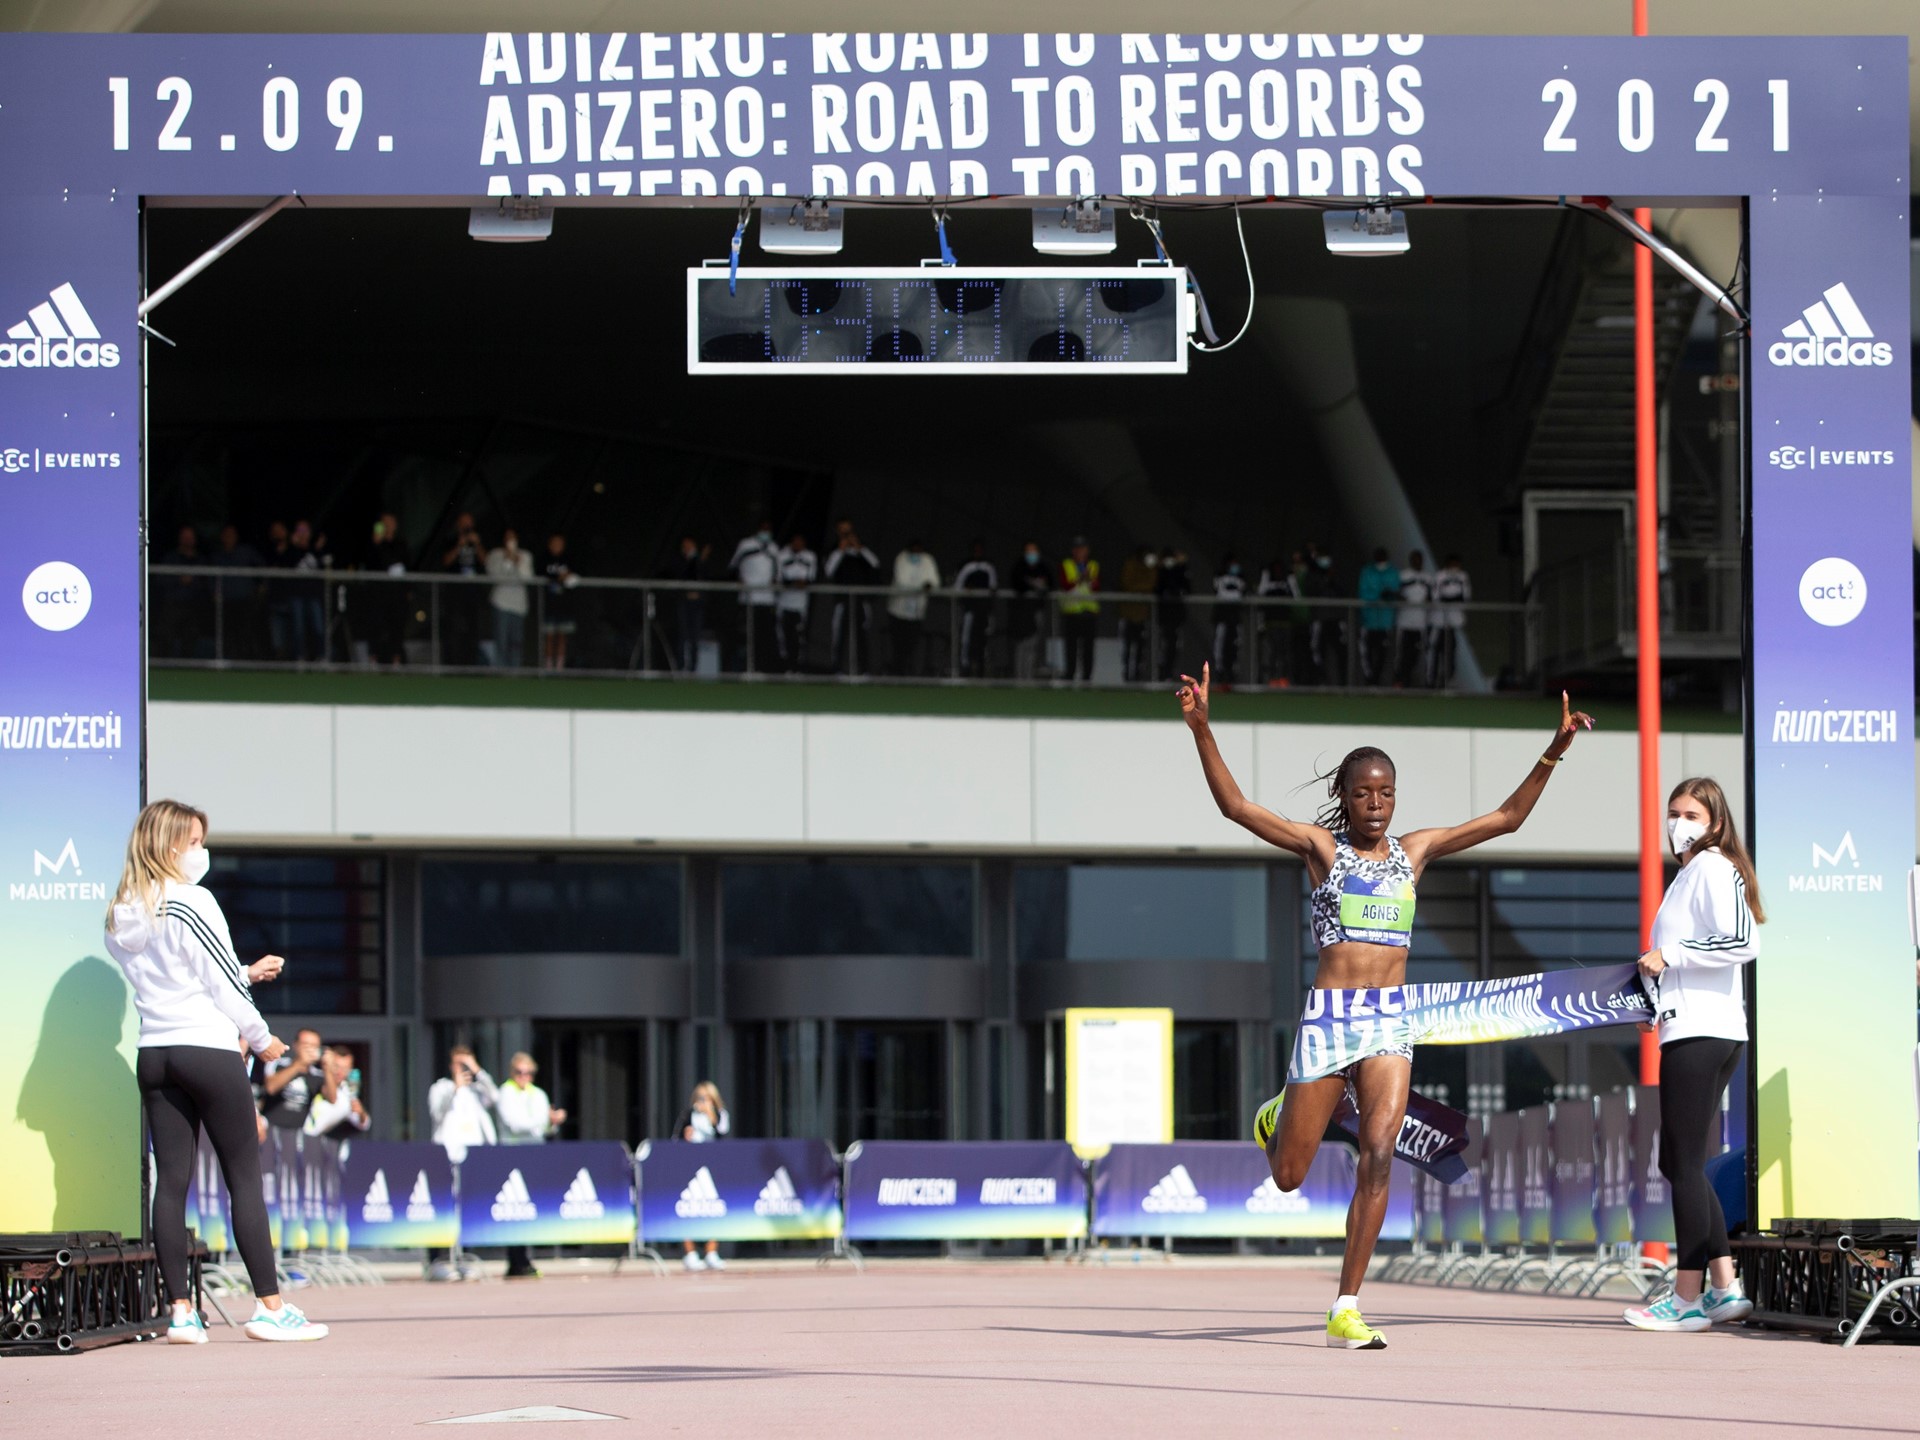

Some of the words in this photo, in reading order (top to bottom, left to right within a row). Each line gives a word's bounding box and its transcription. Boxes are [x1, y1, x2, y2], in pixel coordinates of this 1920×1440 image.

[480, 85, 788, 166] ADIZERO:
[811, 79, 989, 154] ROAD
[1011, 74, 1095, 147] TO
[1120, 65, 1425, 144] RECORDS
[0, 335, 120, 368] adidas
[1768, 335, 1893, 366] adidas
[45, 453, 121, 468] EVENTS
[1769, 446, 1806, 469] SCC
[1820, 450, 1894, 465] EVENTS
[1772, 710, 1897, 742] RUNCZECH
[10, 883, 105, 900] MAURTEN
[1789, 875, 1883, 892] MAURTEN
[1361, 904, 1400, 922] AGNES
